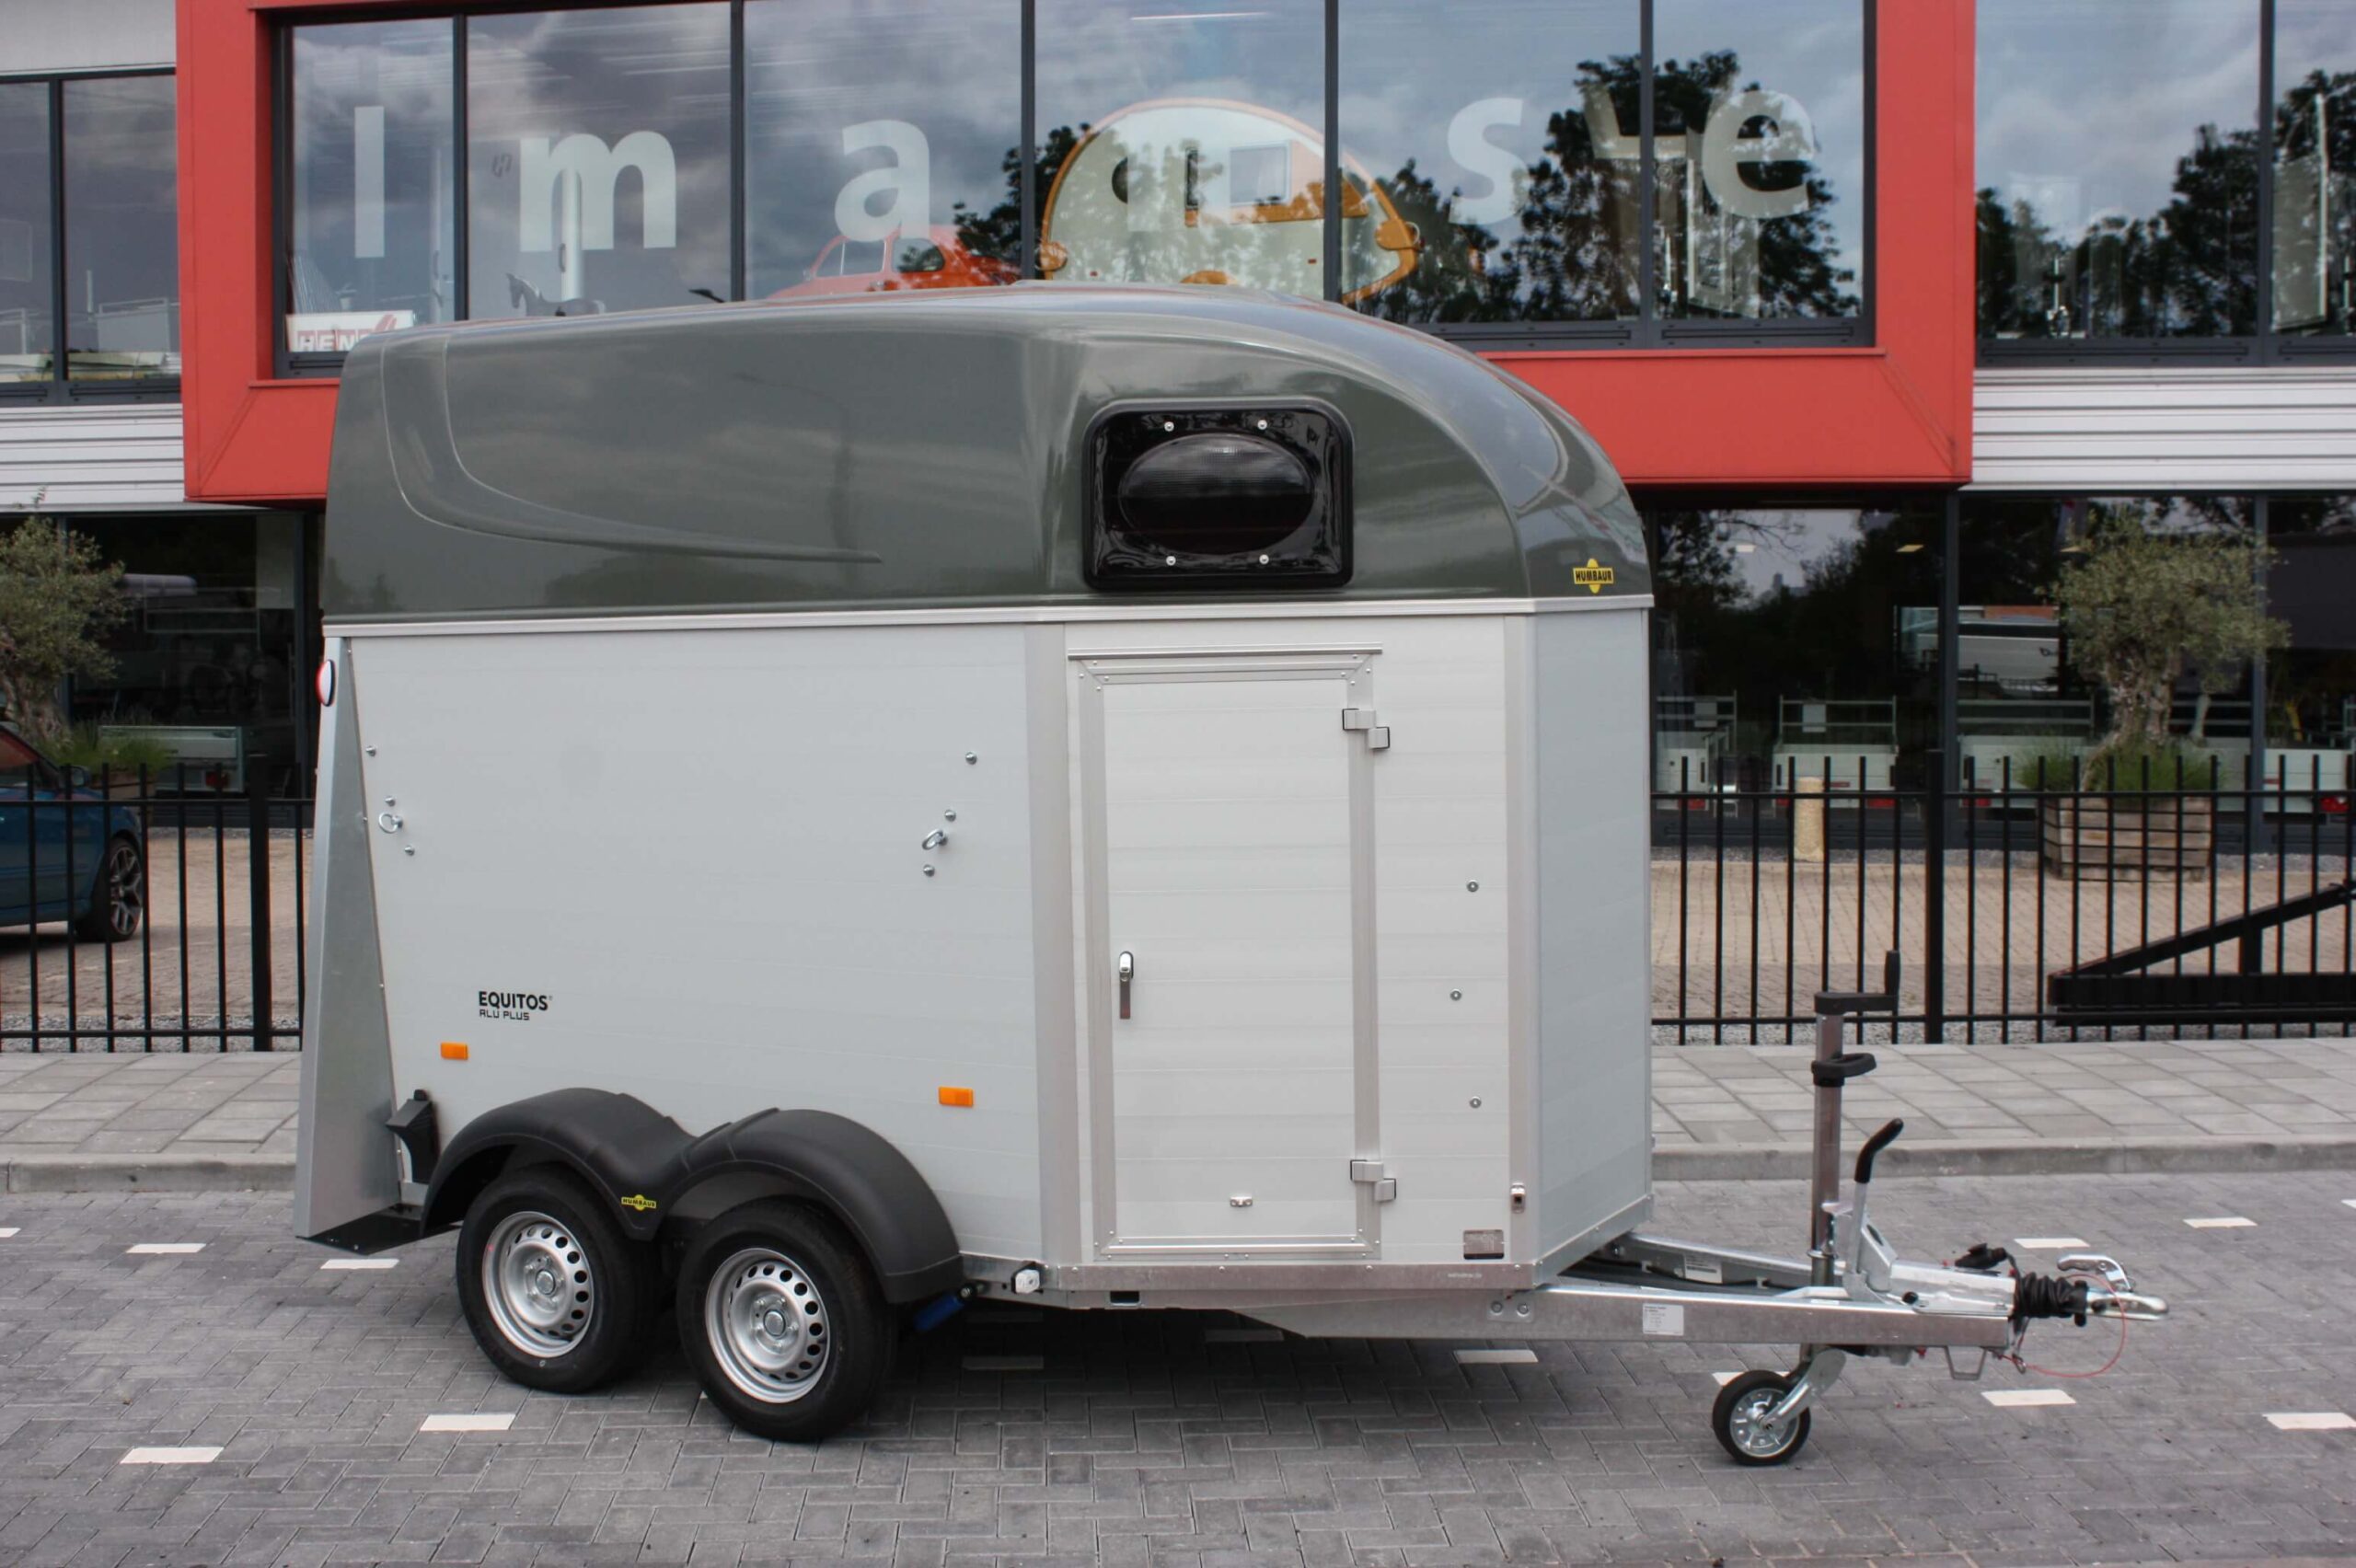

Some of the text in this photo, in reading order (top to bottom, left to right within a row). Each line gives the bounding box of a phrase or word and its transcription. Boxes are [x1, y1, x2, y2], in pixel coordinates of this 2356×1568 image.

[1575, 570, 1611, 582] HUMBAUR
[478, 991, 549, 1010] EQUITOS
[479, 1009, 529, 1020] ALU PLUS
